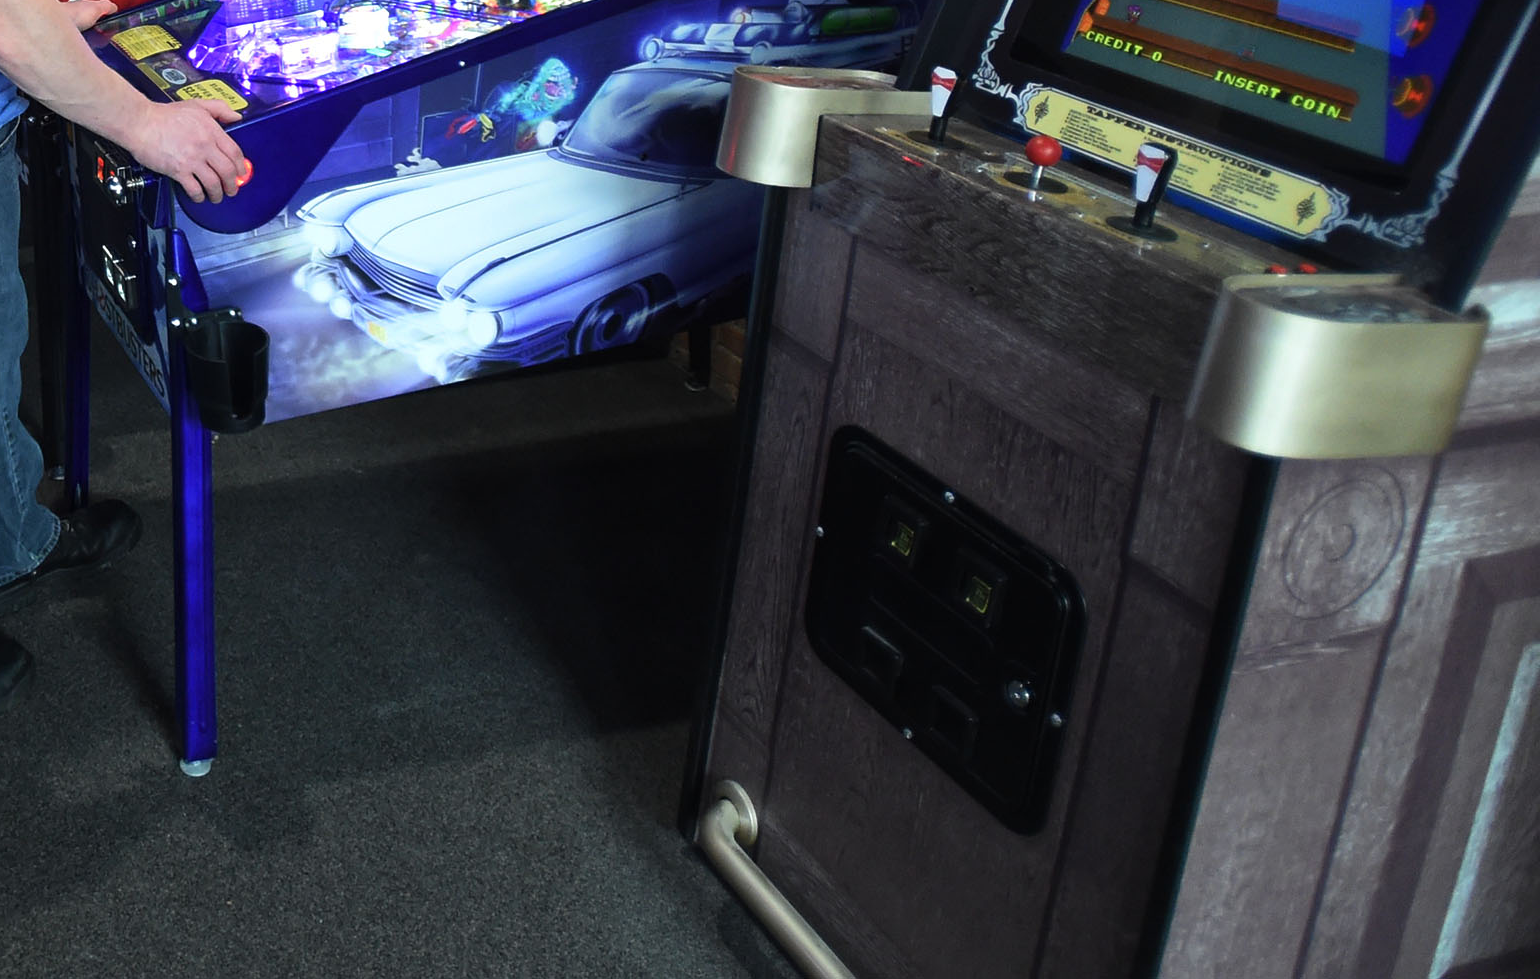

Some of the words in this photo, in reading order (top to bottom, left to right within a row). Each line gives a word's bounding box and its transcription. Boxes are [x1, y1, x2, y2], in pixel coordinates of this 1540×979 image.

[1085, 30, 1143, 56] CREDIT
[1151, 50, 1163, 62] 0
[1214, 70, 1281, 99] INSERT
[1291, 94, 1341, 119] COIN
[1086, 105, 1146, 133] TAPPER
[1148, 127, 1272, 178] INSTRUCTIONS
